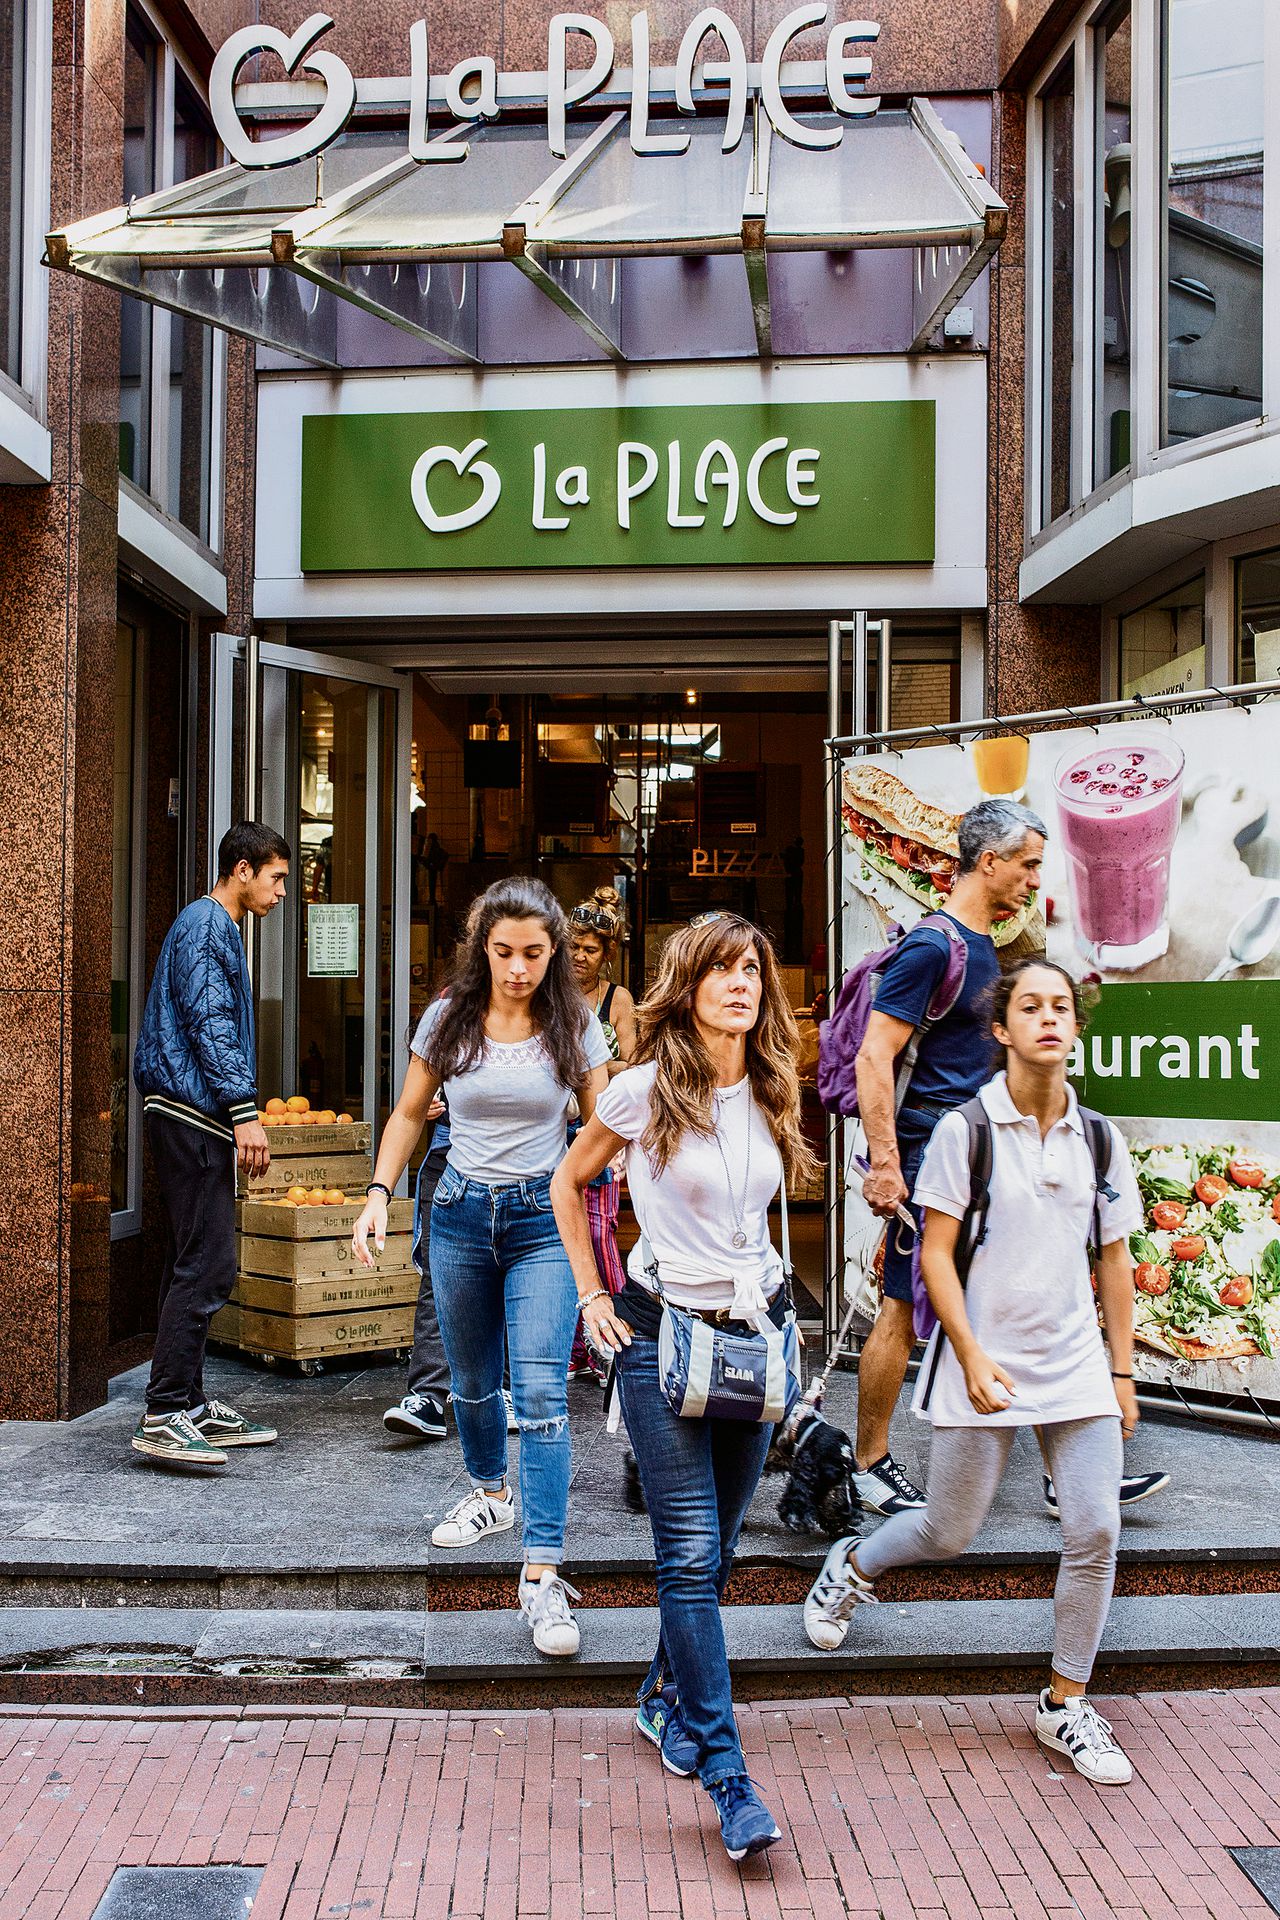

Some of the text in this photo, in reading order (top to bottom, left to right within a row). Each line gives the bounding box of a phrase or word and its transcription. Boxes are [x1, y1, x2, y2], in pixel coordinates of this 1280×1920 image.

[409, 3, 881, 163] La PLACE
[532, 437, 821, 530] La PLACE
[306, 1167, 327, 1181] PLACE
[349, 1323, 382, 1338] La PLACE
[725, 1366, 755, 1382] SLAM
